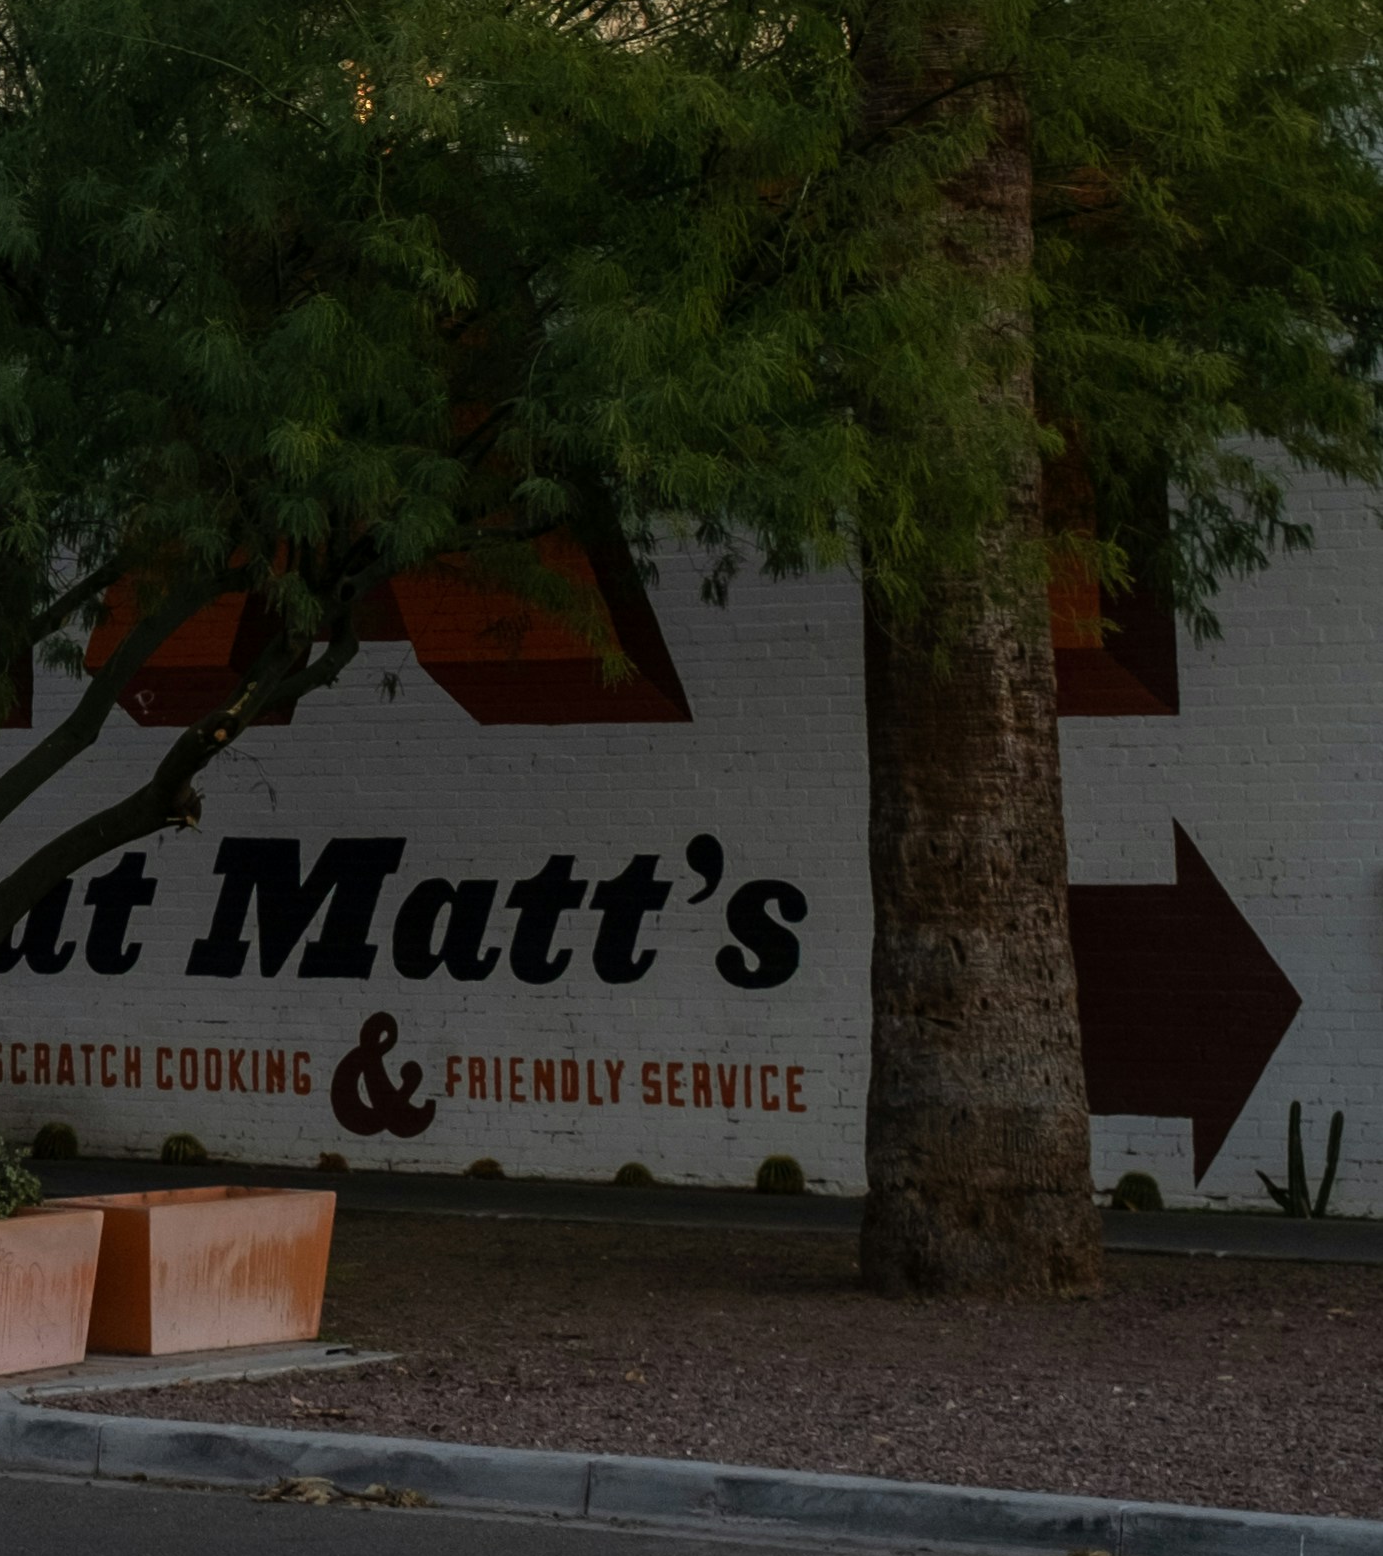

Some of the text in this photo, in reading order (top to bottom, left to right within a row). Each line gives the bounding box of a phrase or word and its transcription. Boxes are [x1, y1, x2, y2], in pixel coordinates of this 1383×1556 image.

[185, 833, 809, 989] Matt's
[156, 1046, 312, 1096] COOKING
[330, 1011, 436, 1138] &
[444, 1055, 625, 1106] FRIENDLY
[641, 1061, 808, 1113] SERVICE
